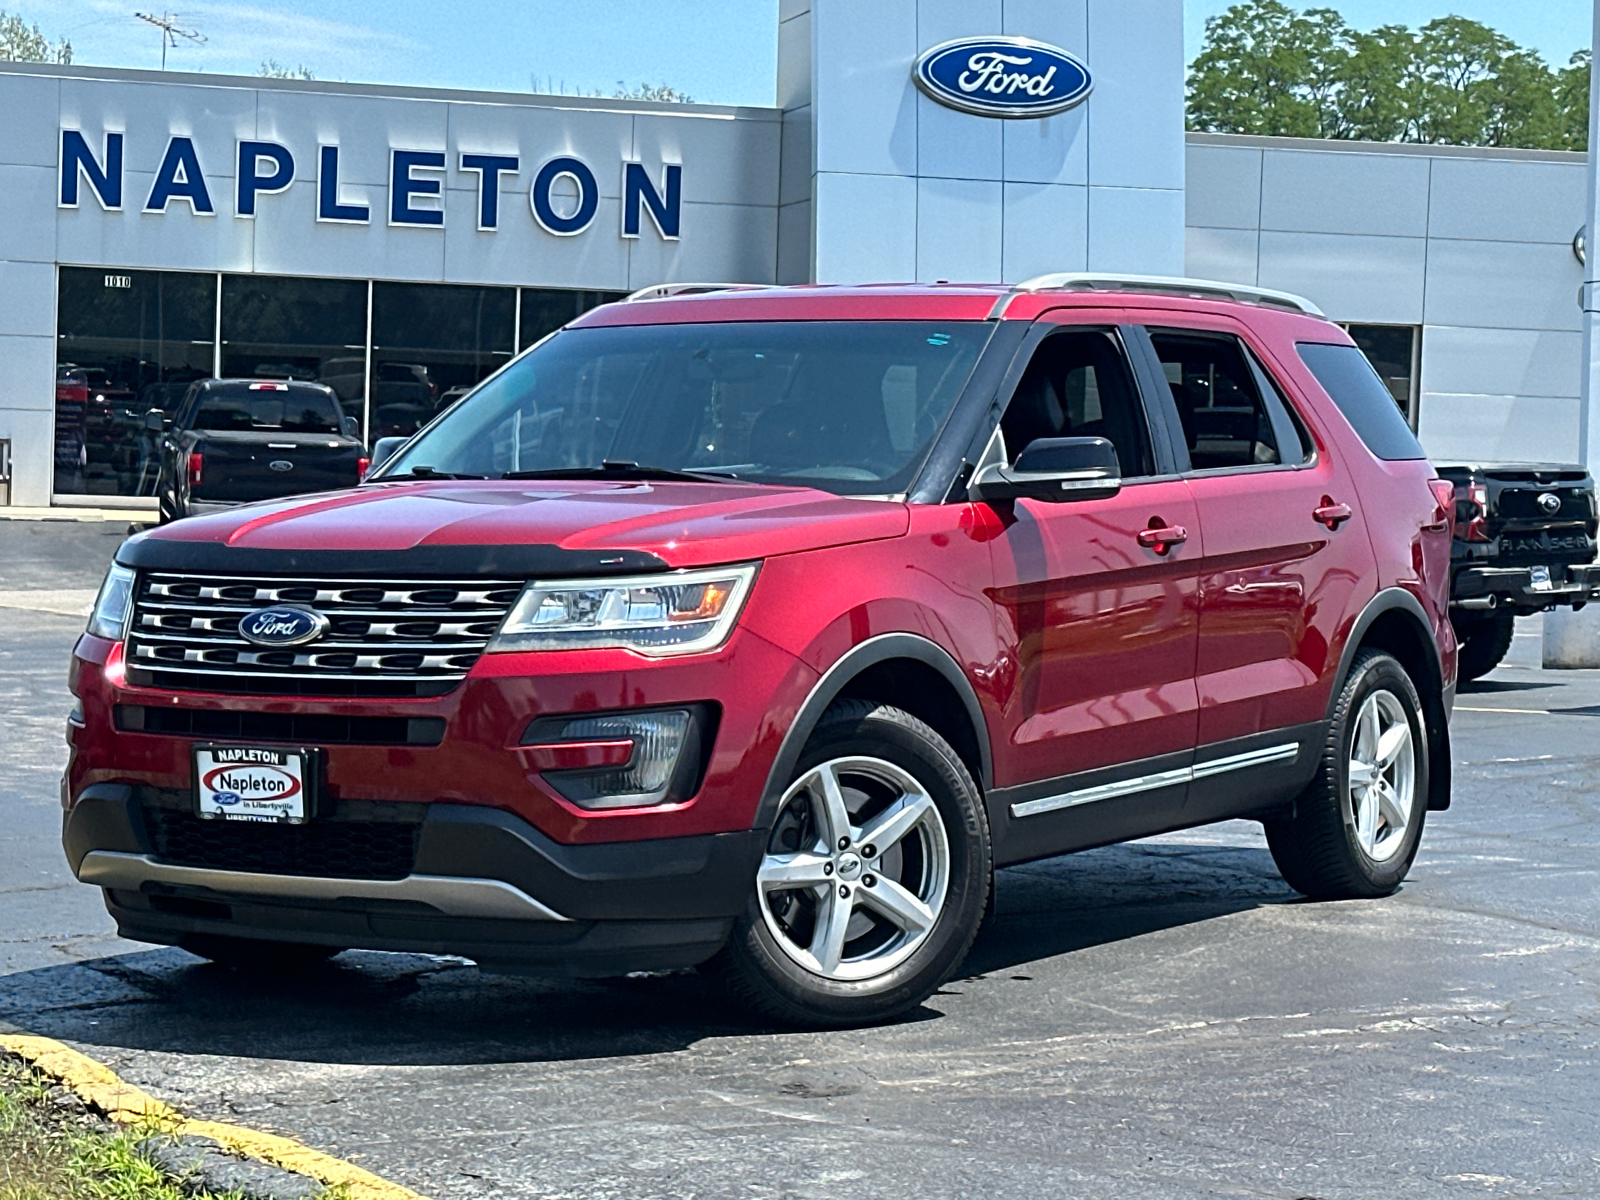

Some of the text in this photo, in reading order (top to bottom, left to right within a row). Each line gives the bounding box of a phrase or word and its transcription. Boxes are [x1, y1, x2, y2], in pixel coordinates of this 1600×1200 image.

[958, 52, 1057, 97] Ford
[58, 128, 684, 241] NAPLETON
[105, 275, 131, 288] 1010
[1500, 536, 1588, 550] RANGER
[252, 613, 300, 635] Ford
[218, 749, 279, 764] NAPLETON
[219, 773, 285, 794] Napleton
